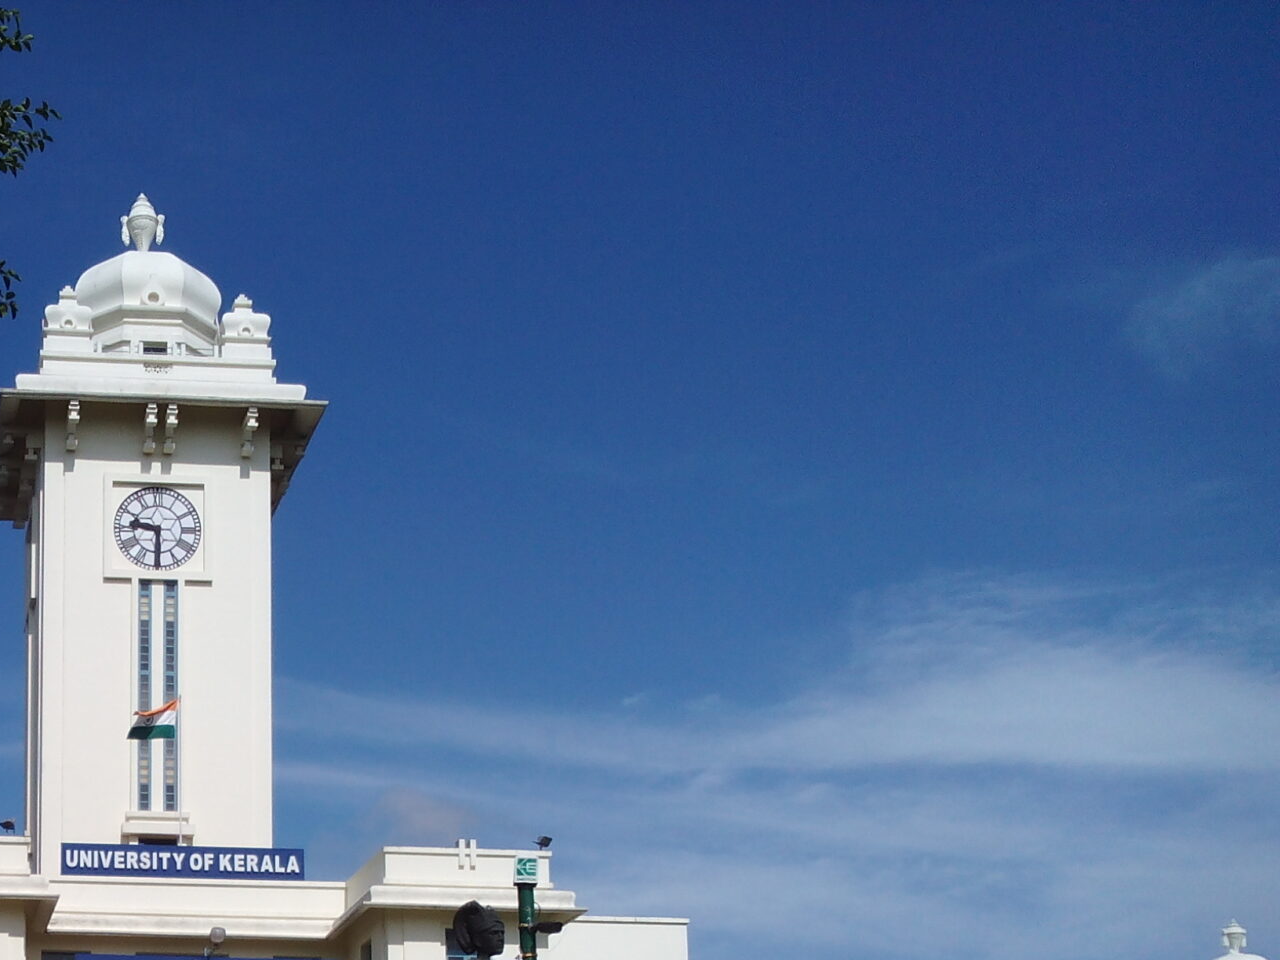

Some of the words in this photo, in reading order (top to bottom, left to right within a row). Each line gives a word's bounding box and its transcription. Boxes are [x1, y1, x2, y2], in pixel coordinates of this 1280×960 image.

[65, 848, 185, 871] UNIVERSITY
[189, 852, 215, 871] OF
[219, 854, 300, 874] KERALA
